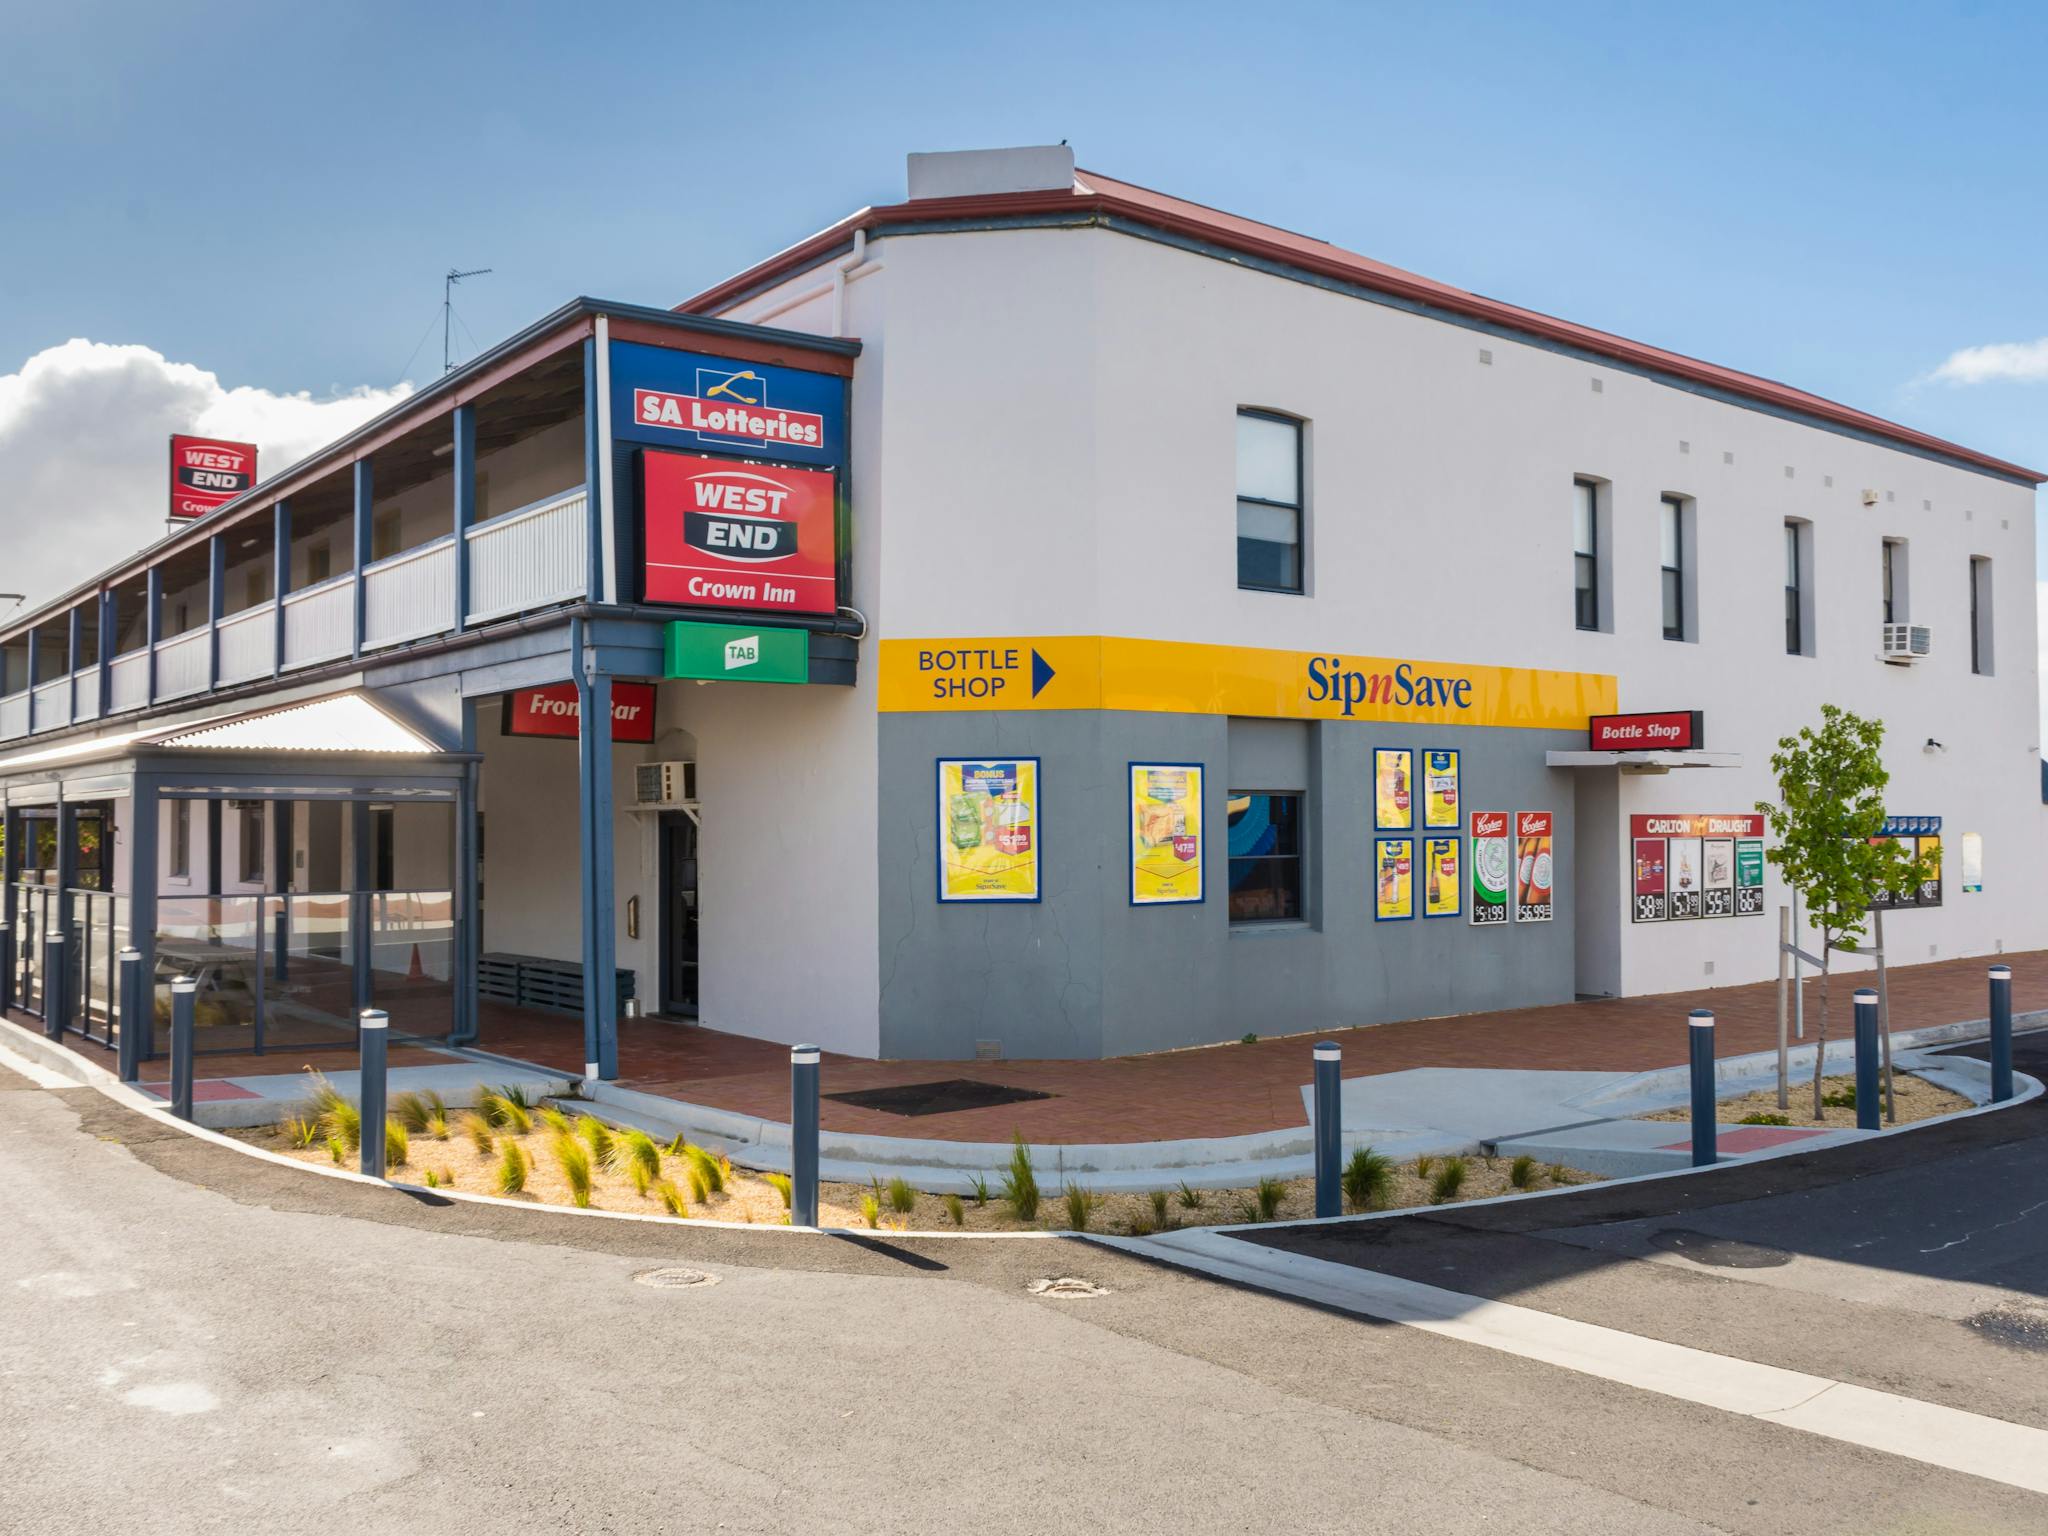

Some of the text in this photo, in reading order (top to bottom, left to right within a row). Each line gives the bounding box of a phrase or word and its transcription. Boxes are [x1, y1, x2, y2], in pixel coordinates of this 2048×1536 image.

[642, 396, 817, 443] SA Lotteries
[185, 450, 244, 470] WEST
[192, 471, 238, 488] END
[694, 481, 788, 514] WEST
[706, 521, 778, 550] END
[688, 577, 795, 603] Crown Inn
[729, 646, 755, 660] TAB
[919, 649, 1019, 671] BOTTLE
[934, 677, 1005, 698] SHOP
[1307, 657, 1472, 716] SipnSave
[530, 694, 640, 720] Fron ar
[1602, 724, 1680, 740] Bottle Shop
[974, 770, 1005, 779] BONUS
[1646, 818, 1752, 833] CARLTON DRAUGHT
